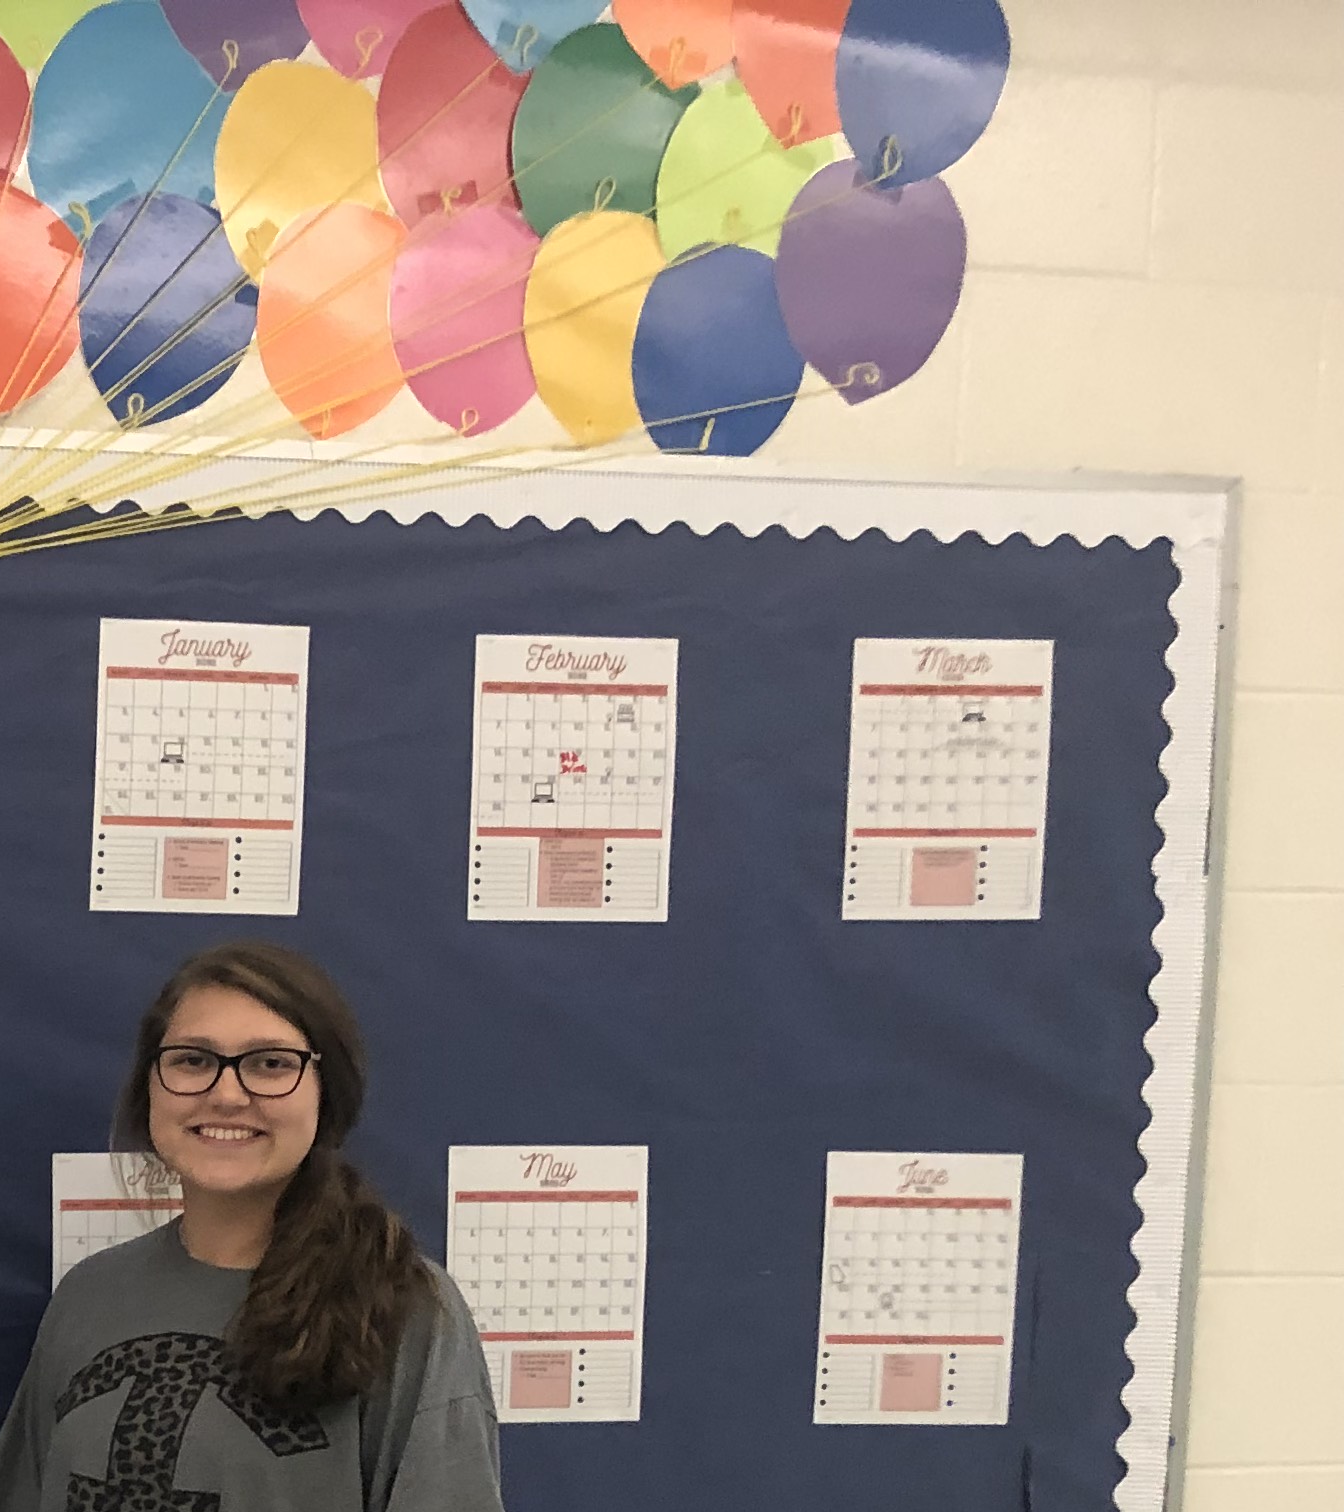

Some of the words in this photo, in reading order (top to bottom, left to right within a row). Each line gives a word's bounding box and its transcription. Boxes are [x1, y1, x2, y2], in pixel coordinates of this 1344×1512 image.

[158, 629, 252, 667] January
[526, 644, 626, 680] February
[913, 646, 993, 679] March
[520, 1153, 577, 1186] May
[896, 1160, 950, 1193] June
